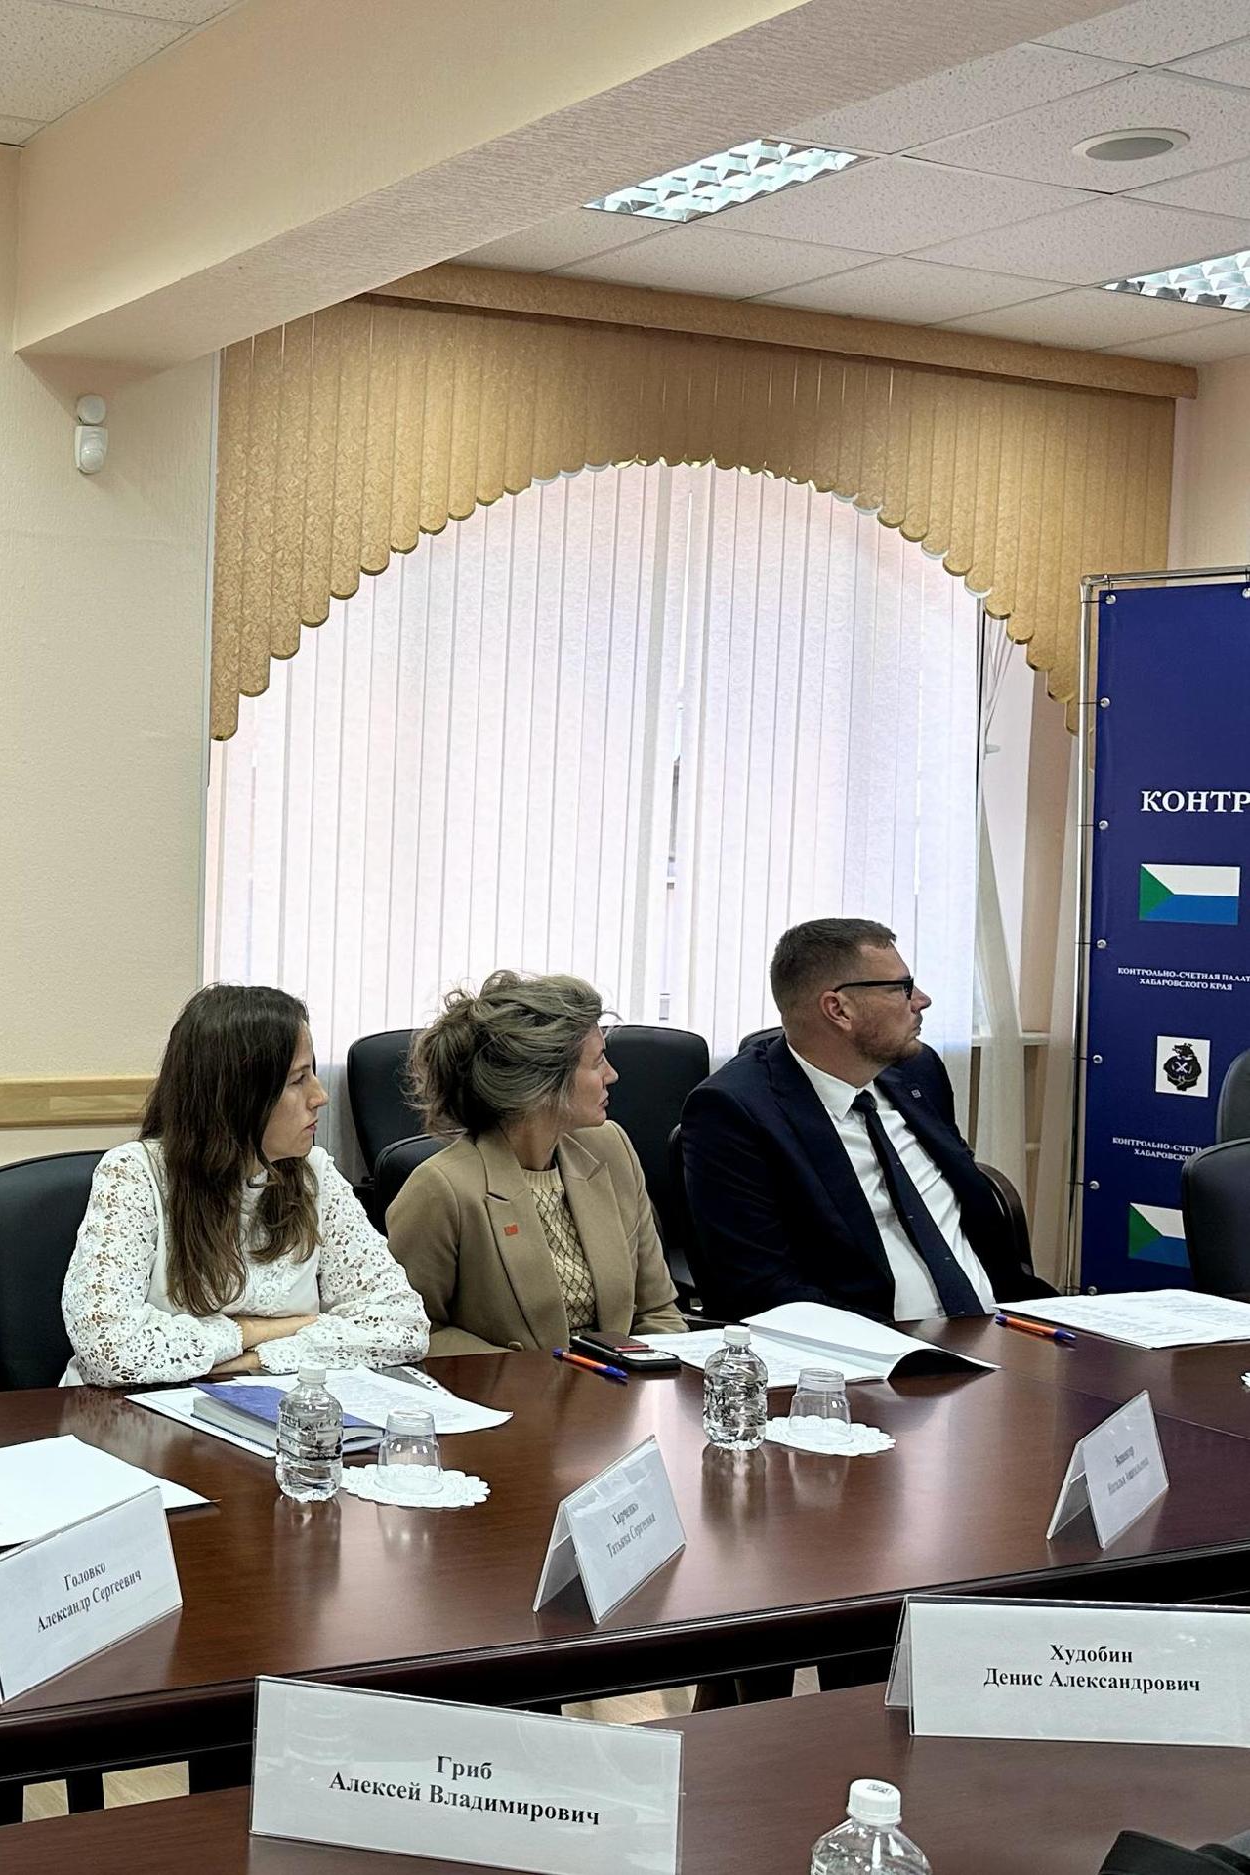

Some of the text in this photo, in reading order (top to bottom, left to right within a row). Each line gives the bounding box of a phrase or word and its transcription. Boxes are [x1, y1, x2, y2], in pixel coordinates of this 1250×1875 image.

[1141, 790, 1250, 813] КОНТР
[1139, 978, 1232, 991] ХАБАРОВСКОГО КРАЯ
[64, 1562, 106, 1591] Головко
[37, 1569, 142, 1633] Александр Сергеевич
[1050, 1645, 1133, 1665] Худобин
[983, 1668, 1200, 1693] Денис Александрович
[436, 1755, 493, 1781] Гриб
[329, 1771, 600, 1826] Алексей Владимирович
